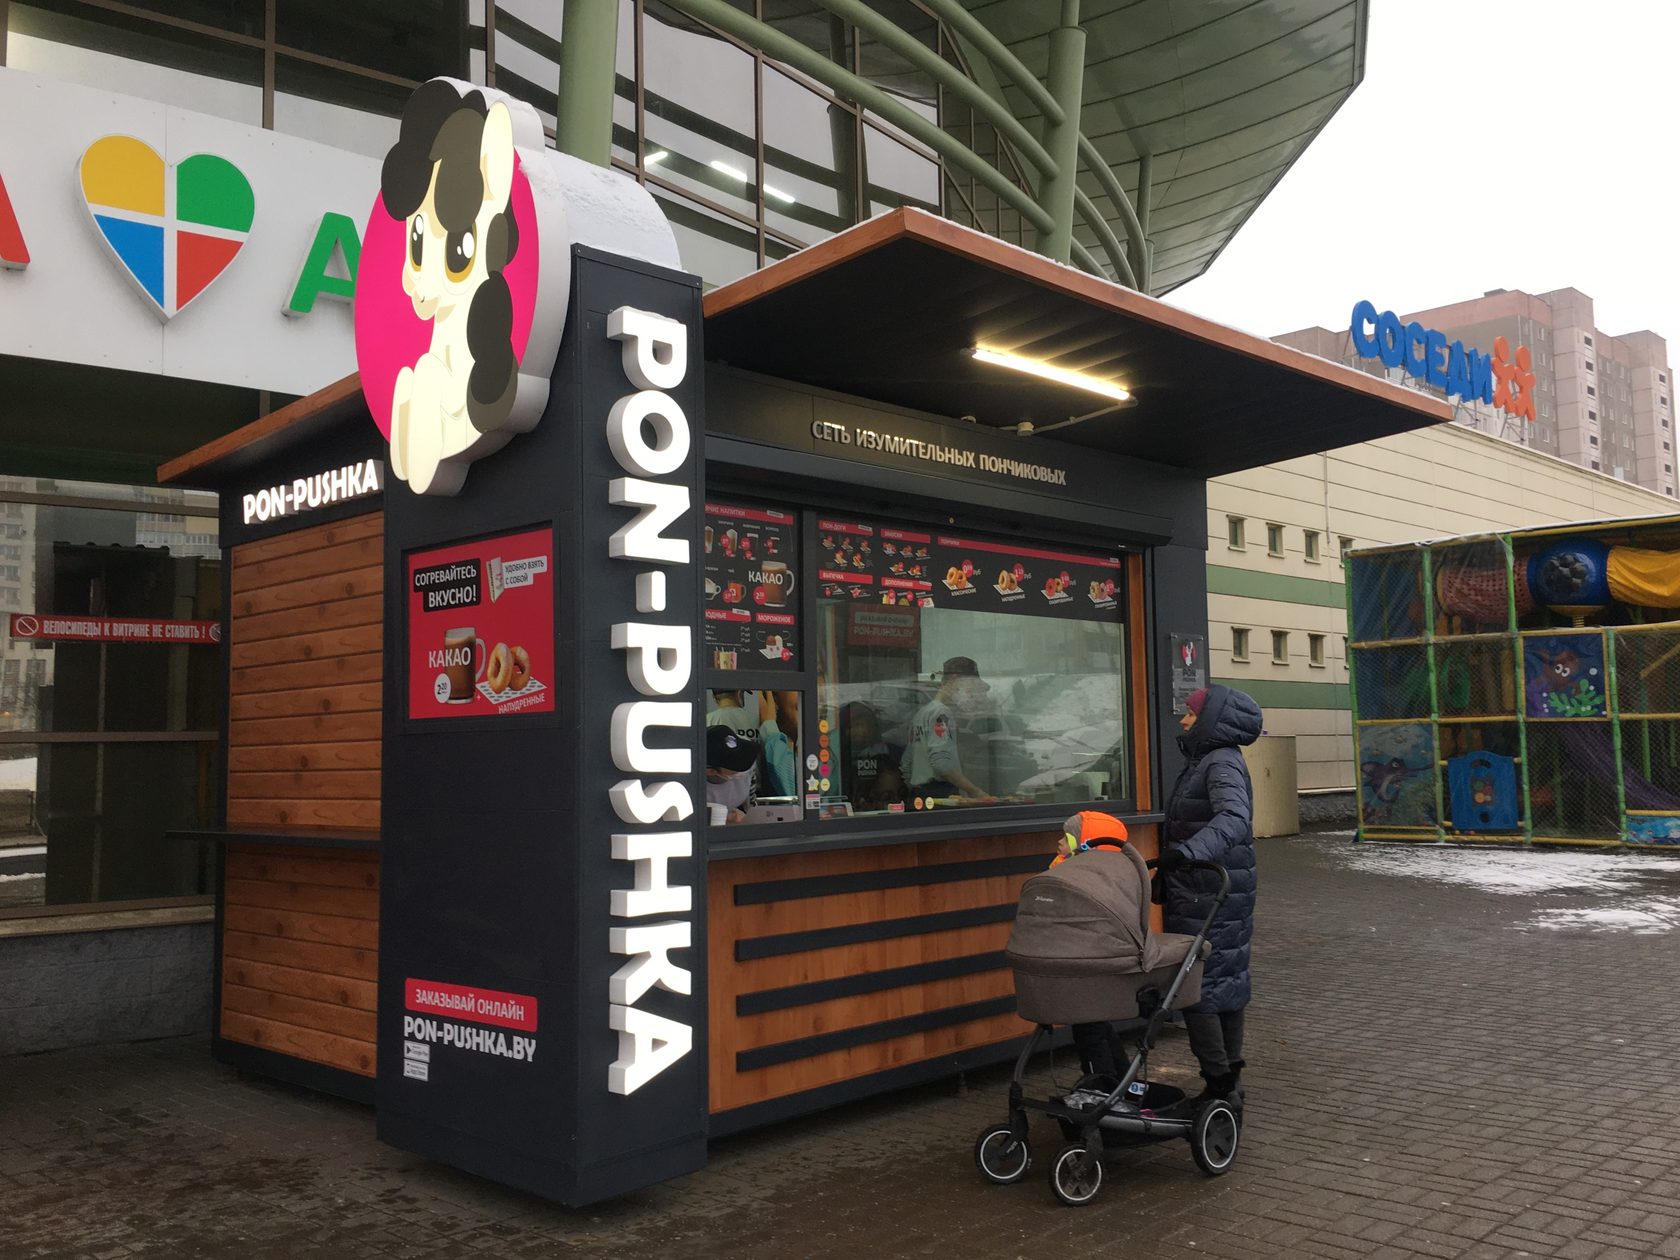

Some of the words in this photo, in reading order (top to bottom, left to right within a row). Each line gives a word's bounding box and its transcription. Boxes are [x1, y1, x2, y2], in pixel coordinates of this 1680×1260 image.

[1351, 300, 1493, 405] СОСЕДИ
[812, 420, 851, 444] СЕТЬ
[856, 428, 976, 468] ИЗУМИТЕЛЬНЫХ
[979, 454, 1067, 486] ПОНЧИКОВЫХ
[242, 458, 380, 525] PON-PUSHKA
[414, 564, 477, 587] СОГРЕВАЙТЕСЬ
[505, 562, 528, 573] УДОБНО
[528, 559, 545, 570] ВЗЯТЬ
[509, 573, 528, 585] СОБОЙ
[748, 570, 784, 586] КАКАО
[428, 584, 477, 609] ВКУСНО!
[43, 620, 101, 637] ВЕЛОСИПЕДЫ
[104, 622, 110, 636] К
[112, 623, 149, 637] ВИТРИНЕ
[152, 624, 163, 637] НЕ
[165, 624, 200, 638] СТАВИТЬ
[428, 647, 471, 669] КАКАО
[498, 692, 545, 714] НАПУДРЕННЫЕ
[606, 305, 694, 1096] PON-PUSHKA
[857, 759, 877, 770] PON
[415, 988, 475, 1013] ЗАКАЗЫВАЙ
[477, 993, 525, 1021] ОНЛАЙН
[403, 1015, 537, 1062] PON-PUSHKA.BY
